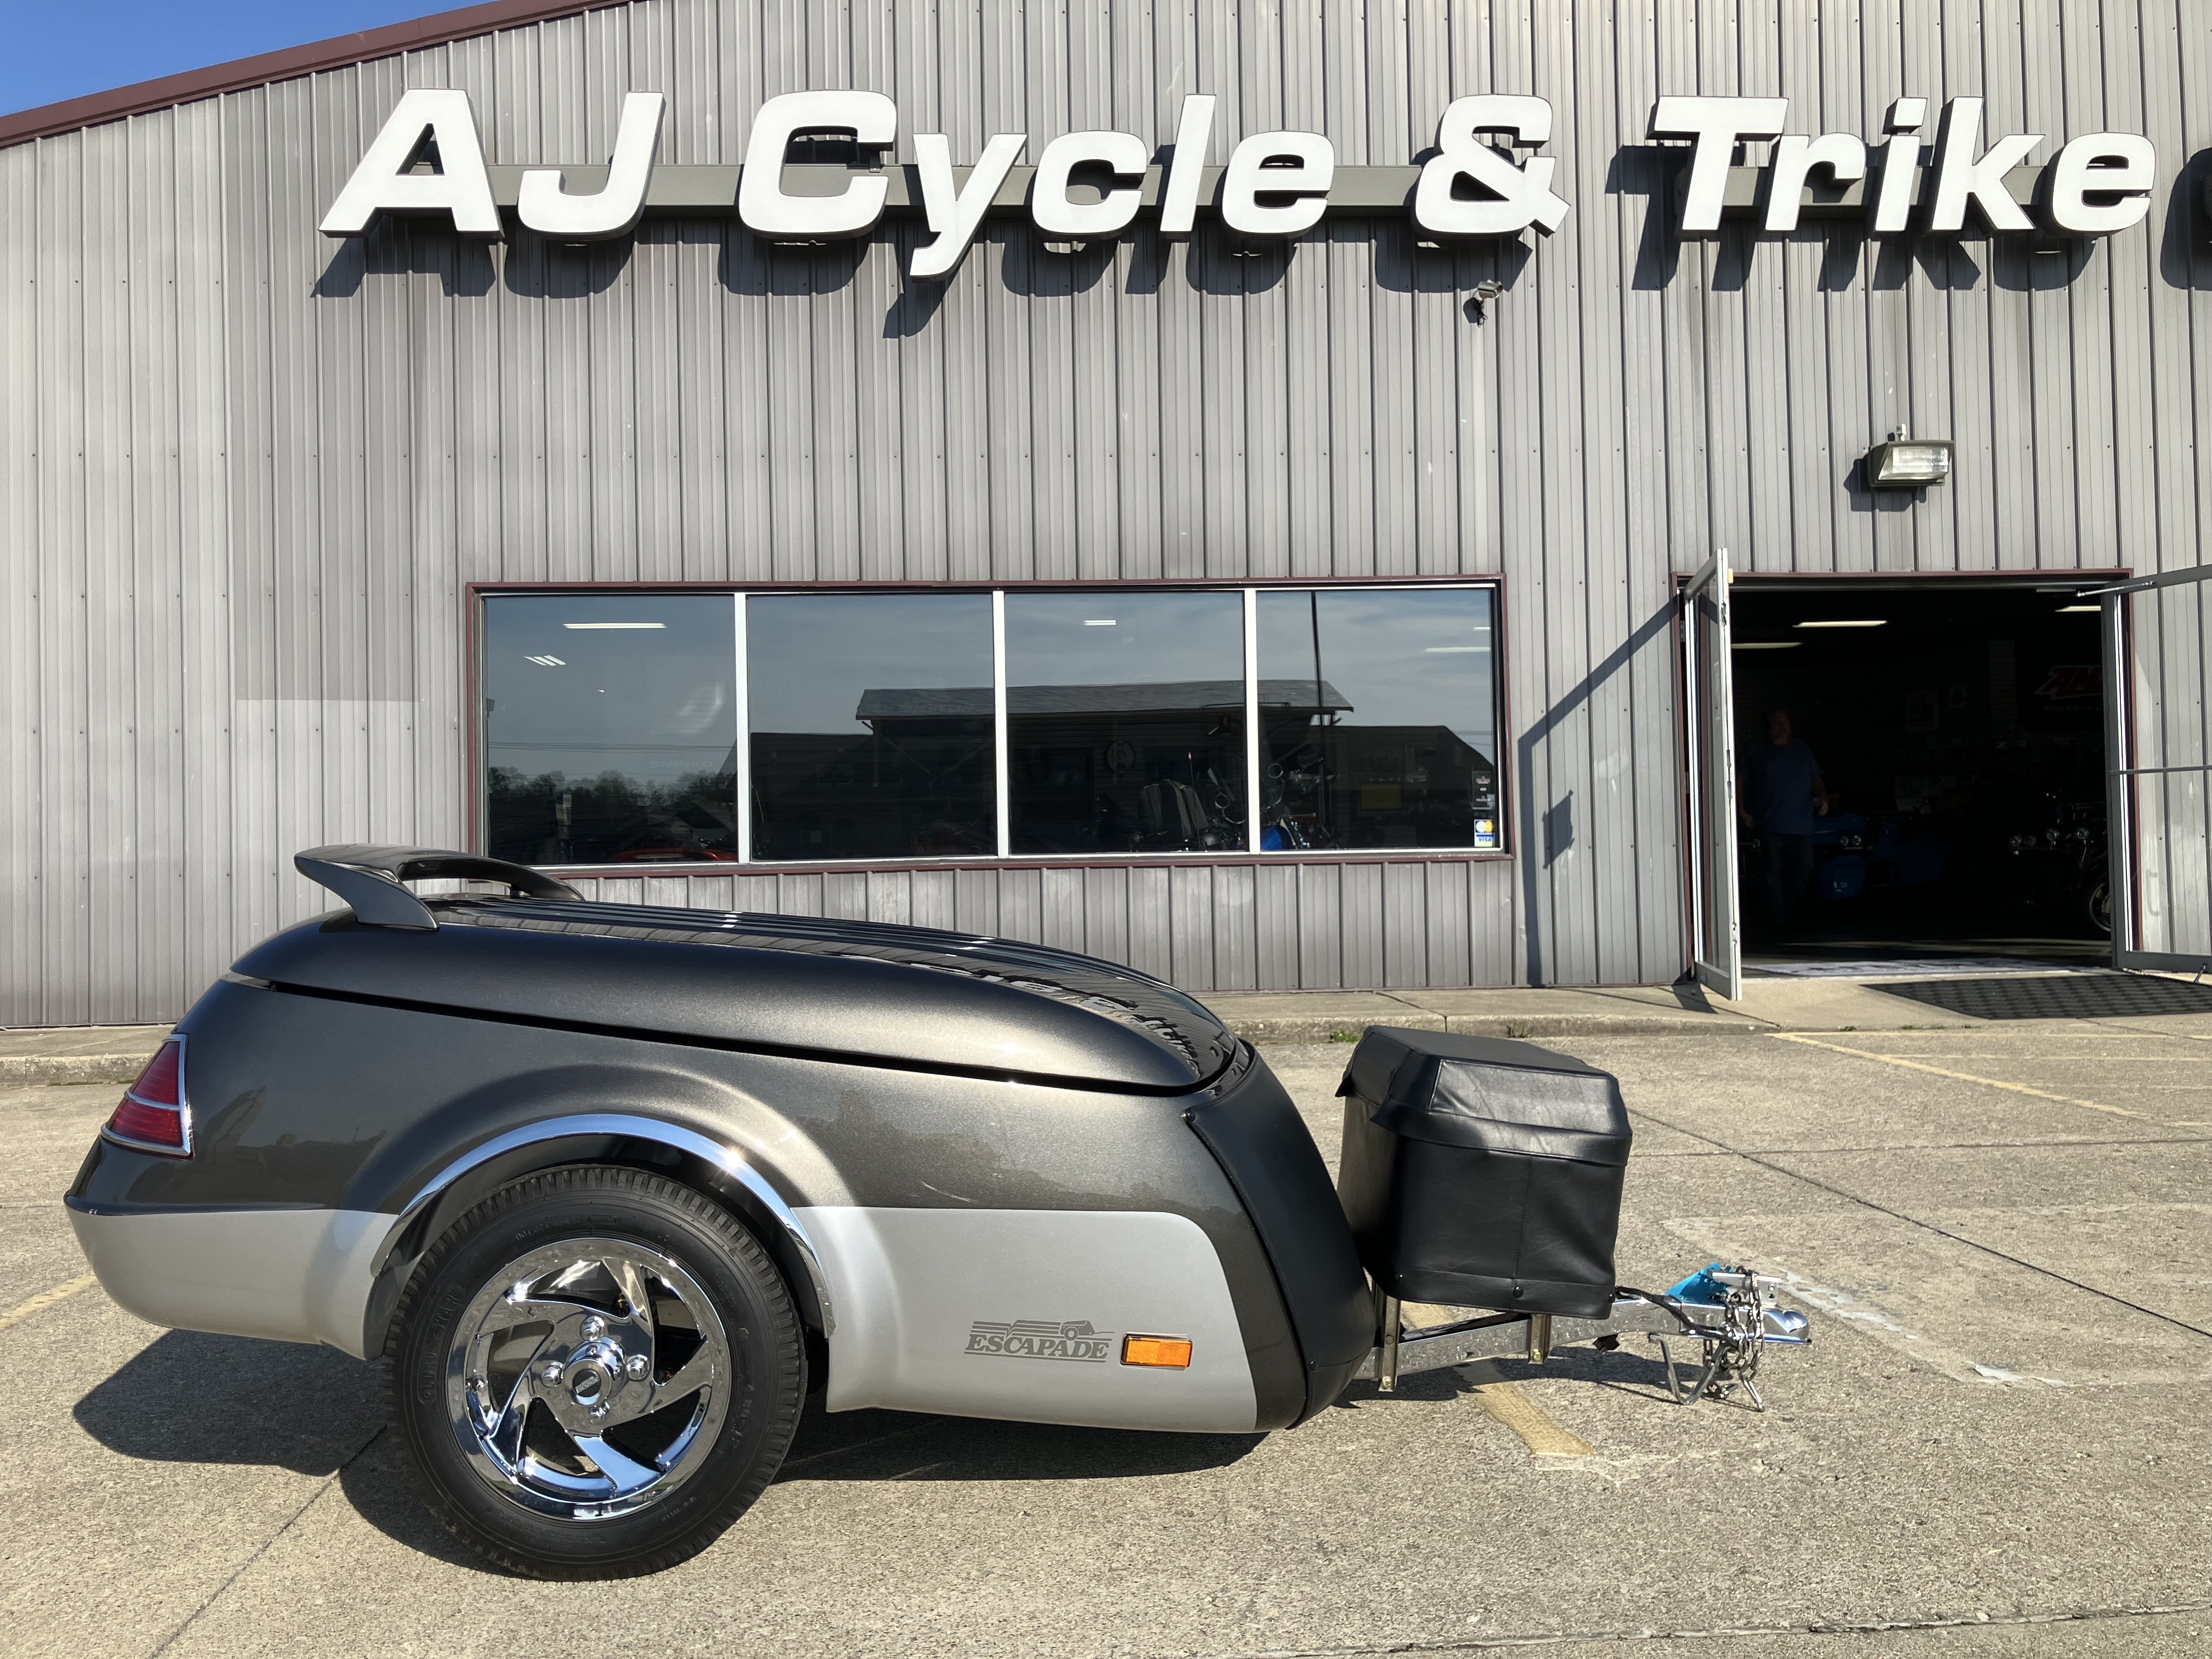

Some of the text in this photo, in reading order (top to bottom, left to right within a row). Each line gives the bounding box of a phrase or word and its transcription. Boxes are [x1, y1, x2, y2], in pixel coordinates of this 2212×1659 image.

[317, 88, 2157, 280] AJ Cycle & Trike
[965, 1334, 1109, 1359] ESCAPADE
